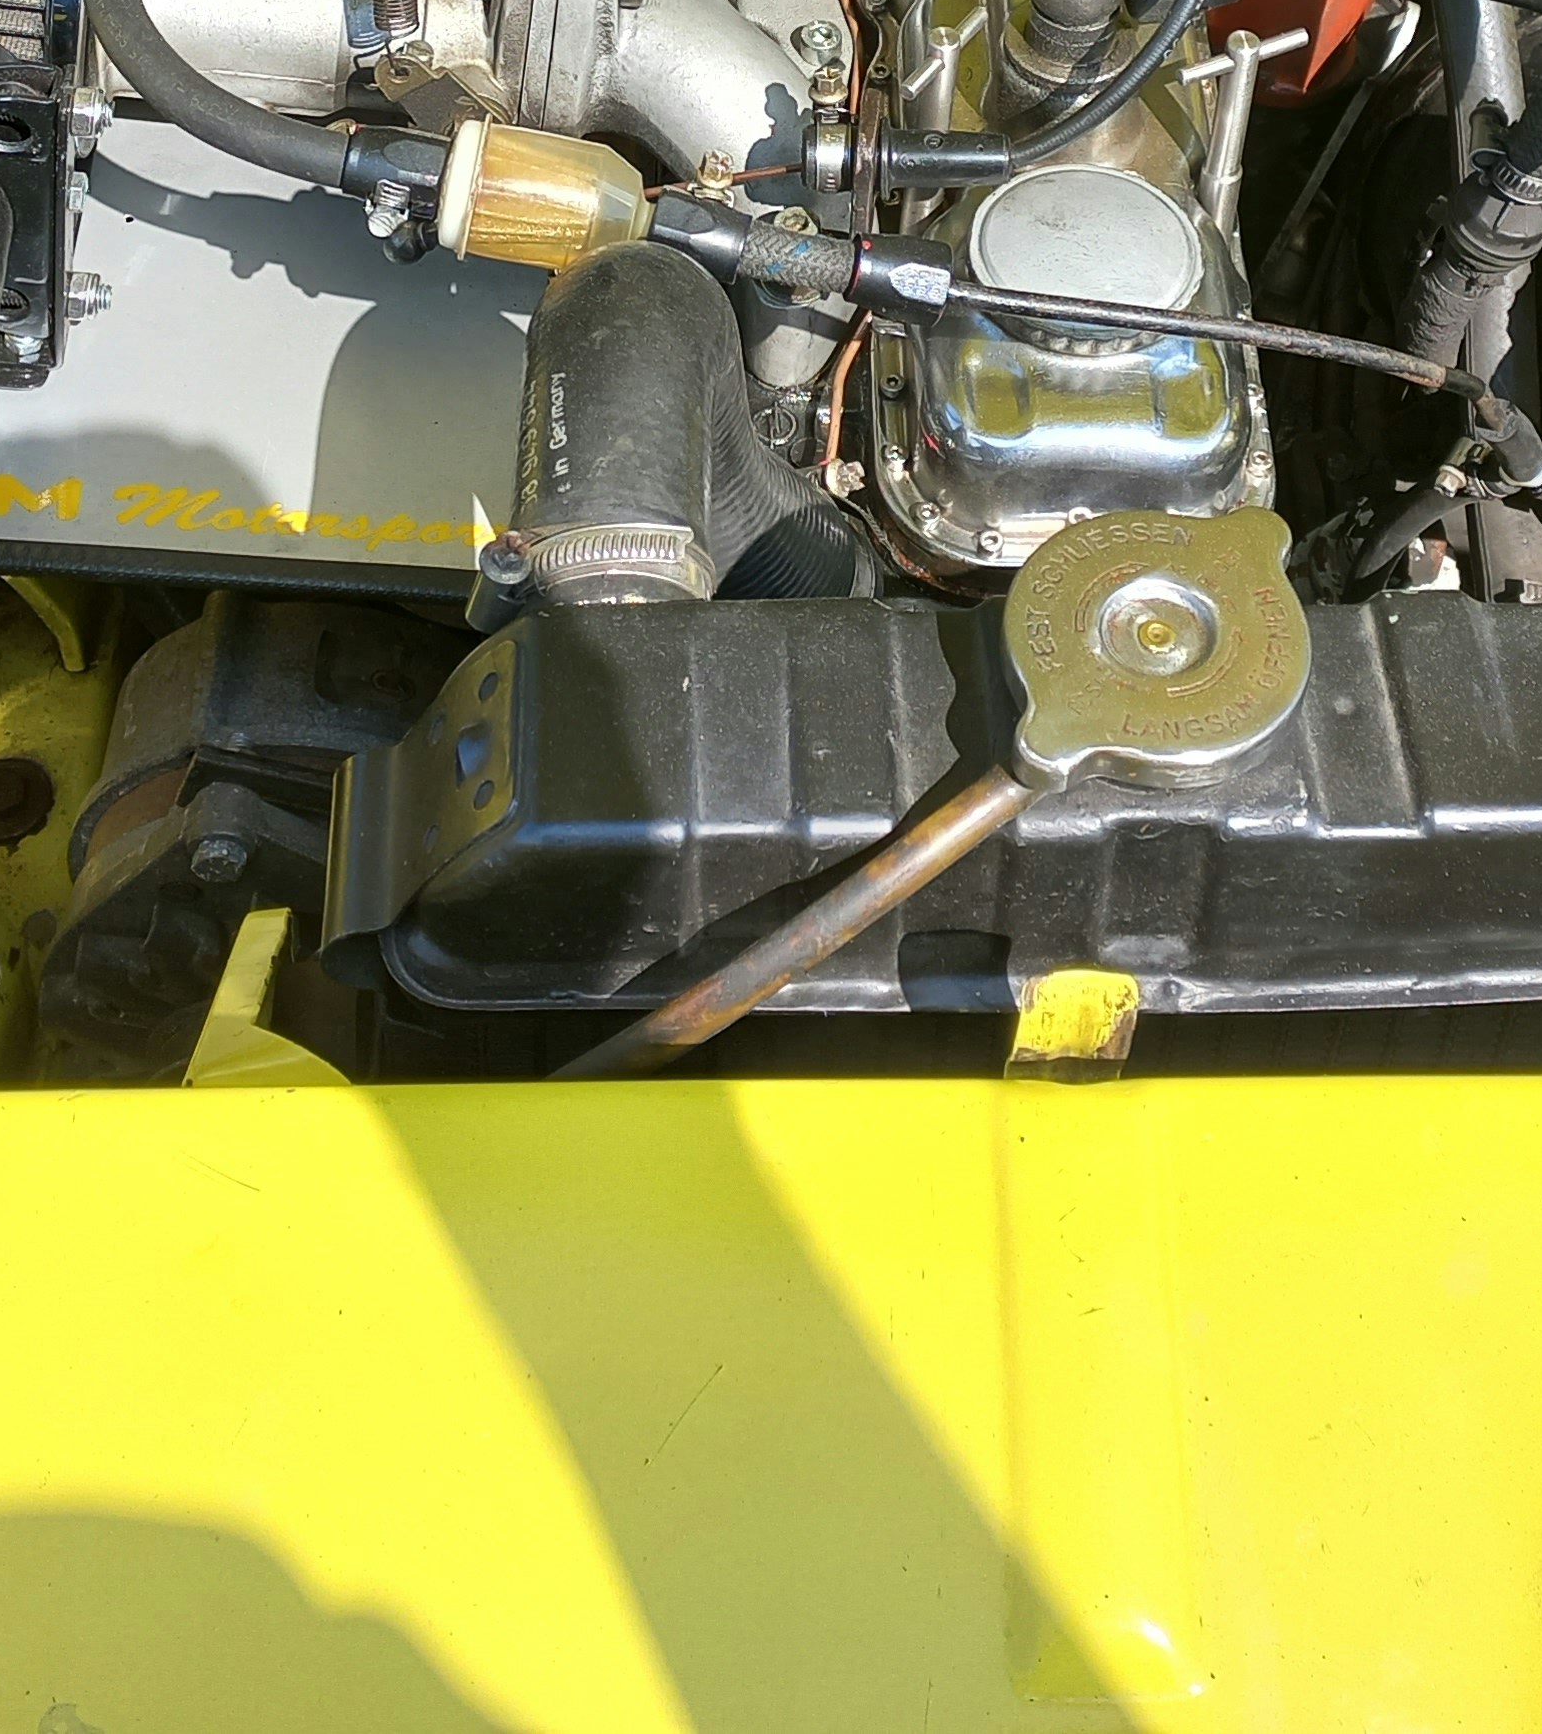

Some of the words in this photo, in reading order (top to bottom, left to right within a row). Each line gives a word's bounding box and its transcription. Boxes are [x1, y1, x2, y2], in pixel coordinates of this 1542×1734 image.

[549, 372, 567, 450] Germany
[1033, 521, 1194, 602] SCHLIESSEN
[1027, 607, 1061, 673] FEST
[1122, 690, 1259, 742] LANGSAM
[1248, 585, 1293, 691] ÖFFNEN
